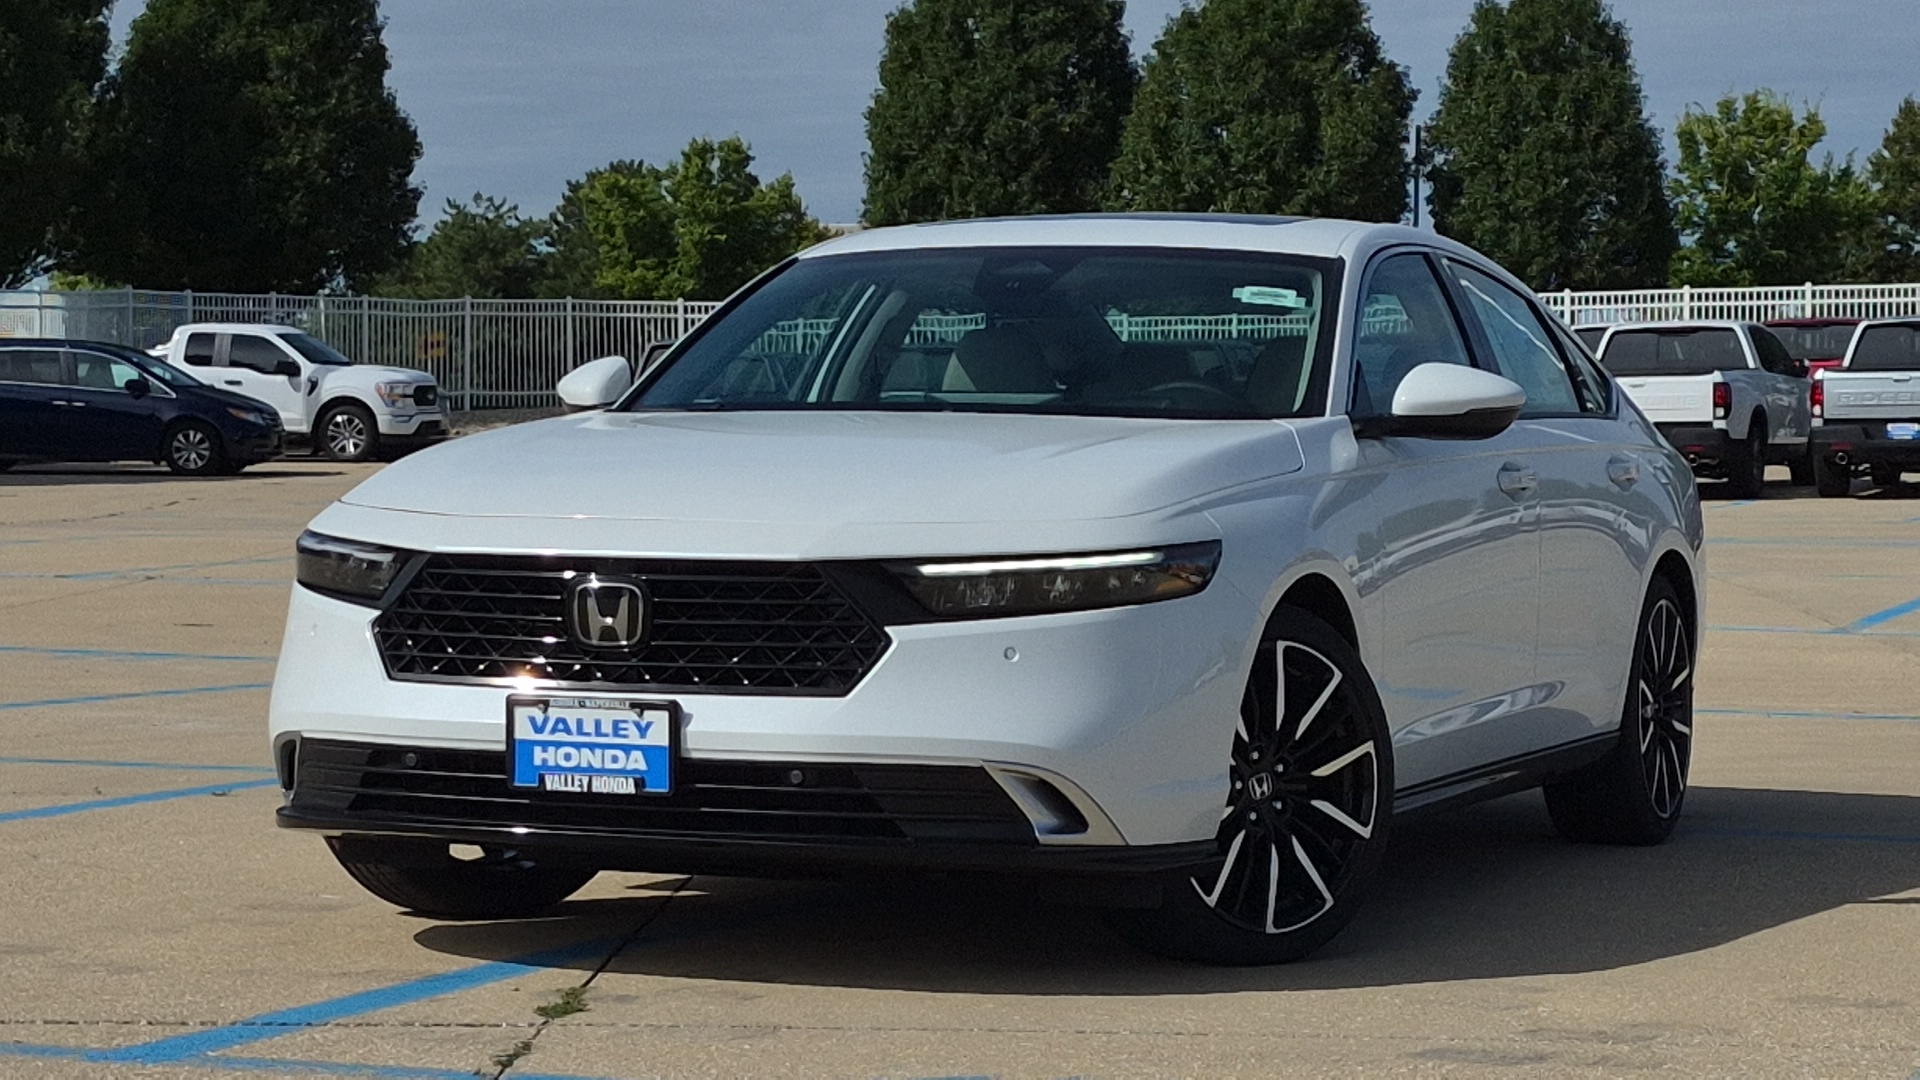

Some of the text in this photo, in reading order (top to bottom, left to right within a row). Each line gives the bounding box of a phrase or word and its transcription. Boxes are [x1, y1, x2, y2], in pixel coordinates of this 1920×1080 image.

[528, 715, 654, 739] VALLEY
[533, 746, 648, 770] HONDA
[545, 774, 636, 794] VALLEY HONDA
